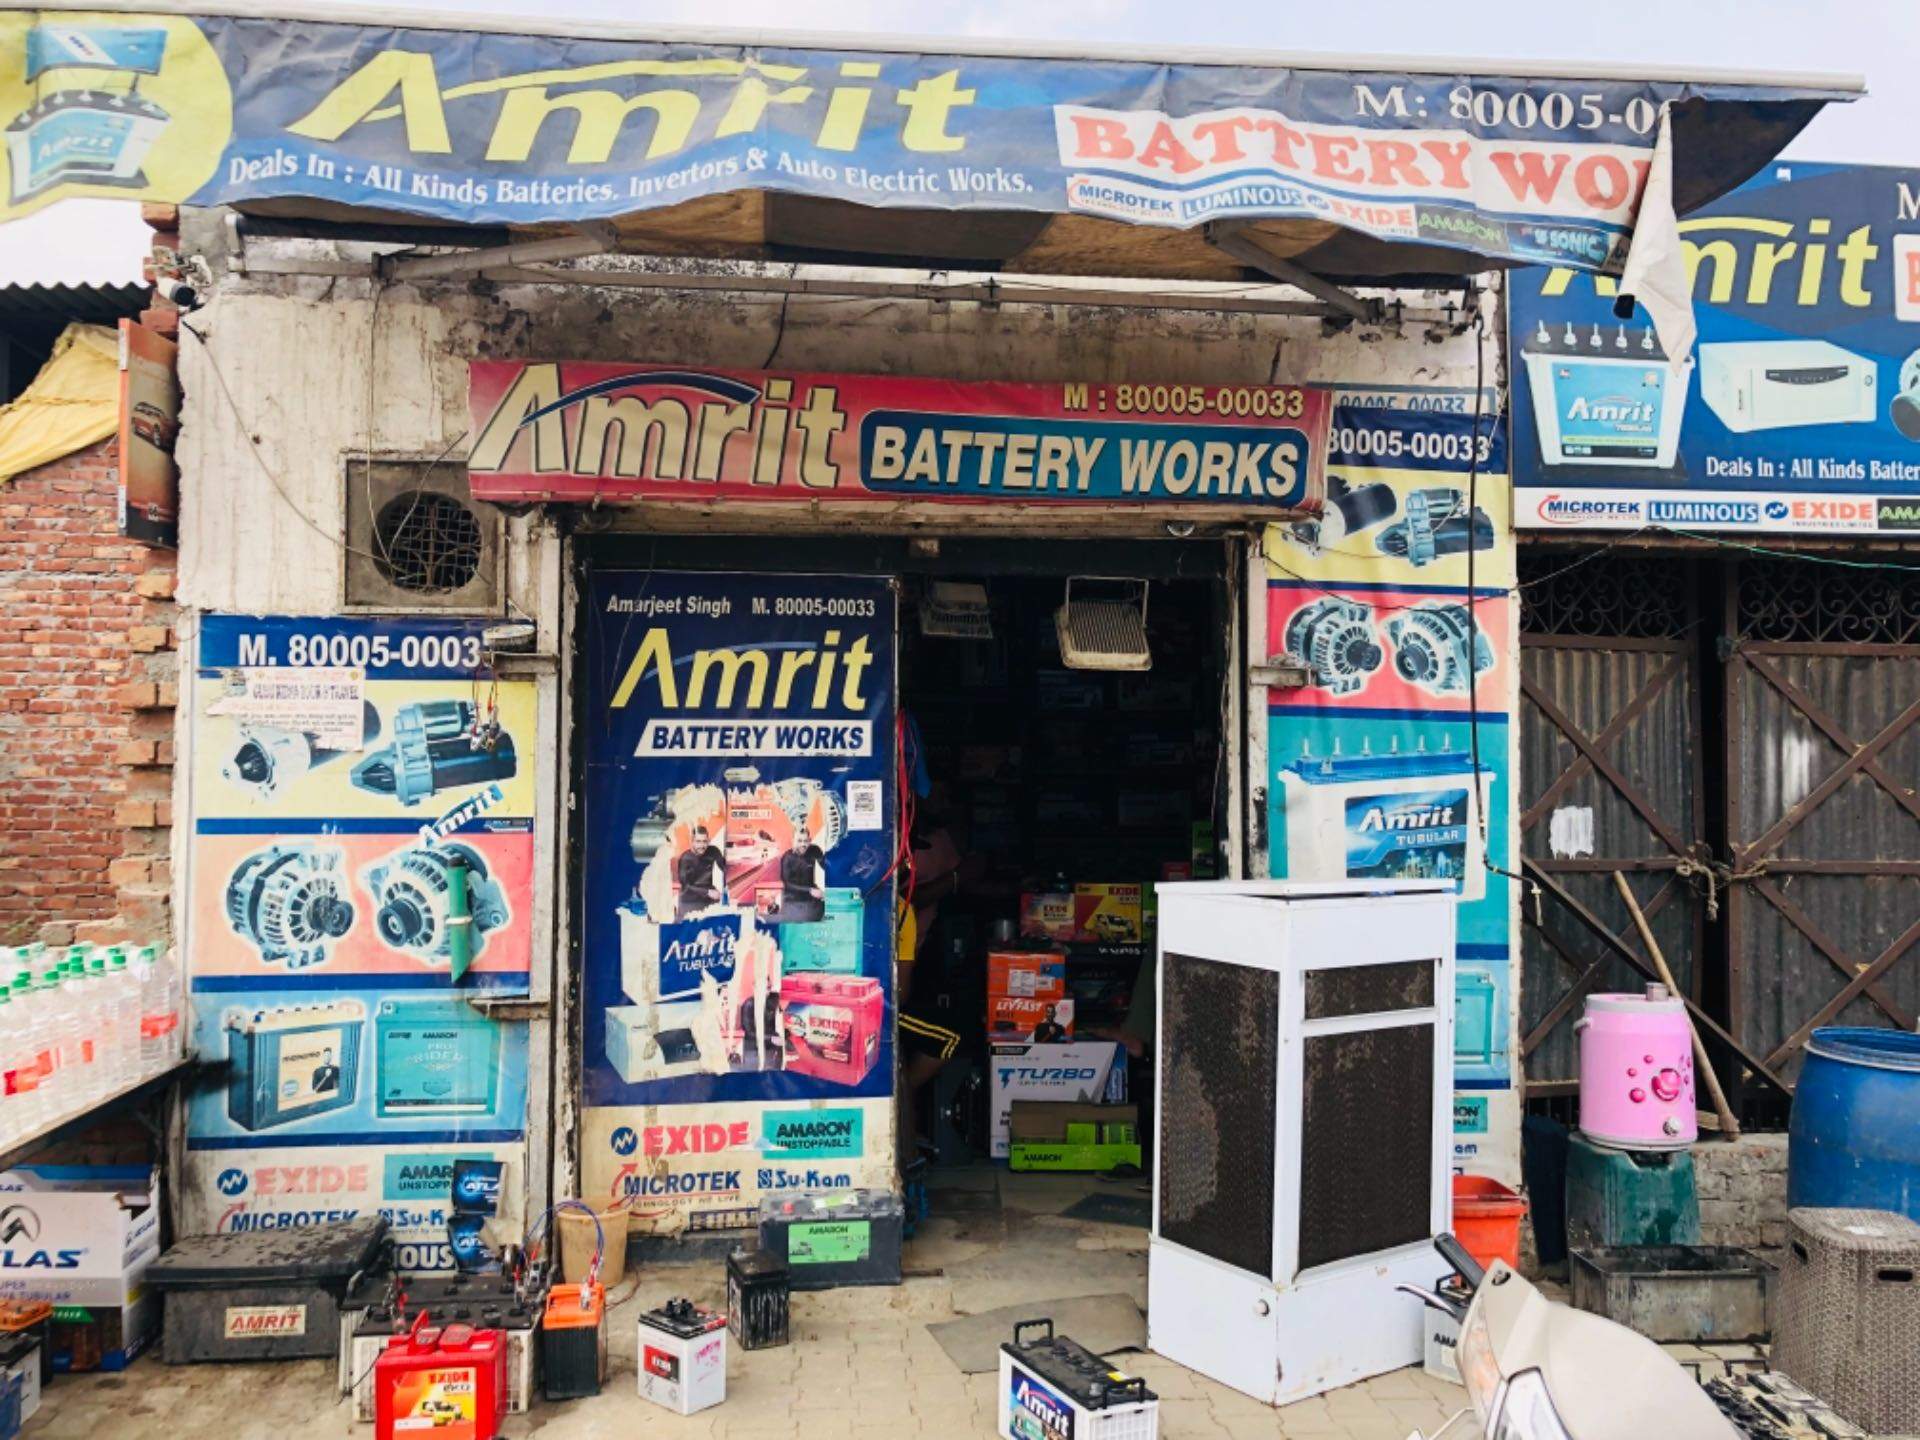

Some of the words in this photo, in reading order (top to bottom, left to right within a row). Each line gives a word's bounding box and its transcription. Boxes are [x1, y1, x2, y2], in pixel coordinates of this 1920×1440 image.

[284, 50, 976, 163] Amrit
[1070, 115, 1471, 190] BATTERY
[230, 150, 298, 185] Deals
[307, 154, 334, 181] In
[364, 165, 401, 193] All
[410, 173, 489, 204] Kinds
[497, 180, 619, 204] Batteries.
[630, 152, 739, 198] Invertors
[745, 147, 768, 170] &
[778, 152, 837, 181] Auto
[845, 167, 939, 192] Electric
[948, 167, 1033, 192] Works.
[1079, 184, 1174, 212] MICROTEK
[1185, 186, 1301, 219] LUMINOUS
[1329, 199, 1413, 227] EXIDE
[1418, 212, 1500, 241] AMARON
[1550, 228, 1600, 259] SONIC
[1541, 217, 1878, 308] mrit
[1063, 383, 1088, 411] M
[1115, 385, 1304, 419] 80005-00033
[1567, 397, 1655, 423] Amrit
[468, 362, 845, 488] Amrit
[1329, 427, 1489, 462] 80005-00033
[870, 425, 1106, 492] BATTERY
[1119, 438, 1299, 498] WORKS
[1706, 456, 1753, 478] Deals
[1758, 457, 1774, 478] In
[1790, 458, 1814, 480] All
[1819, 458, 1865, 481] Kinds
[1548, 501, 1641, 514] MICROTEK
[1650, 502, 1758, 521] LUMINOUS
[1791, 501, 1874, 521] EXIDE
[607, 595, 681, 617] Amarjeet
[686, 596, 731, 618] Singh
[752, 598, 770, 615] M.
[775, 598, 875, 617] 80005-00033
[238, 633, 277, 667] M.
[610, 627, 873, 710] Amrit
[652, 726, 768, 750] BATTERY
[776, 727, 864, 750] WORKS
[1358, 805, 1454, 833] Amrit
[1396, 829, 1459, 846] TUBULAR
[663, 931, 736, 962] Amrit
[643, 1121, 750, 1157] EXIDE
[776, 1121, 851, 1138] AMARON
[252, 1164, 369, 1195] EXIDE
[623, 1170, 741, 1196] MICROTEK
[230, 1208, 360, 1233] MICROTEK
[0, 1249, 83, 1268] LAS
[393, 1244, 455, 1269] OUS
[230, 1310, 302, 1330] AMRIT
[1016, 1379, 1070, 1438] Amrit
